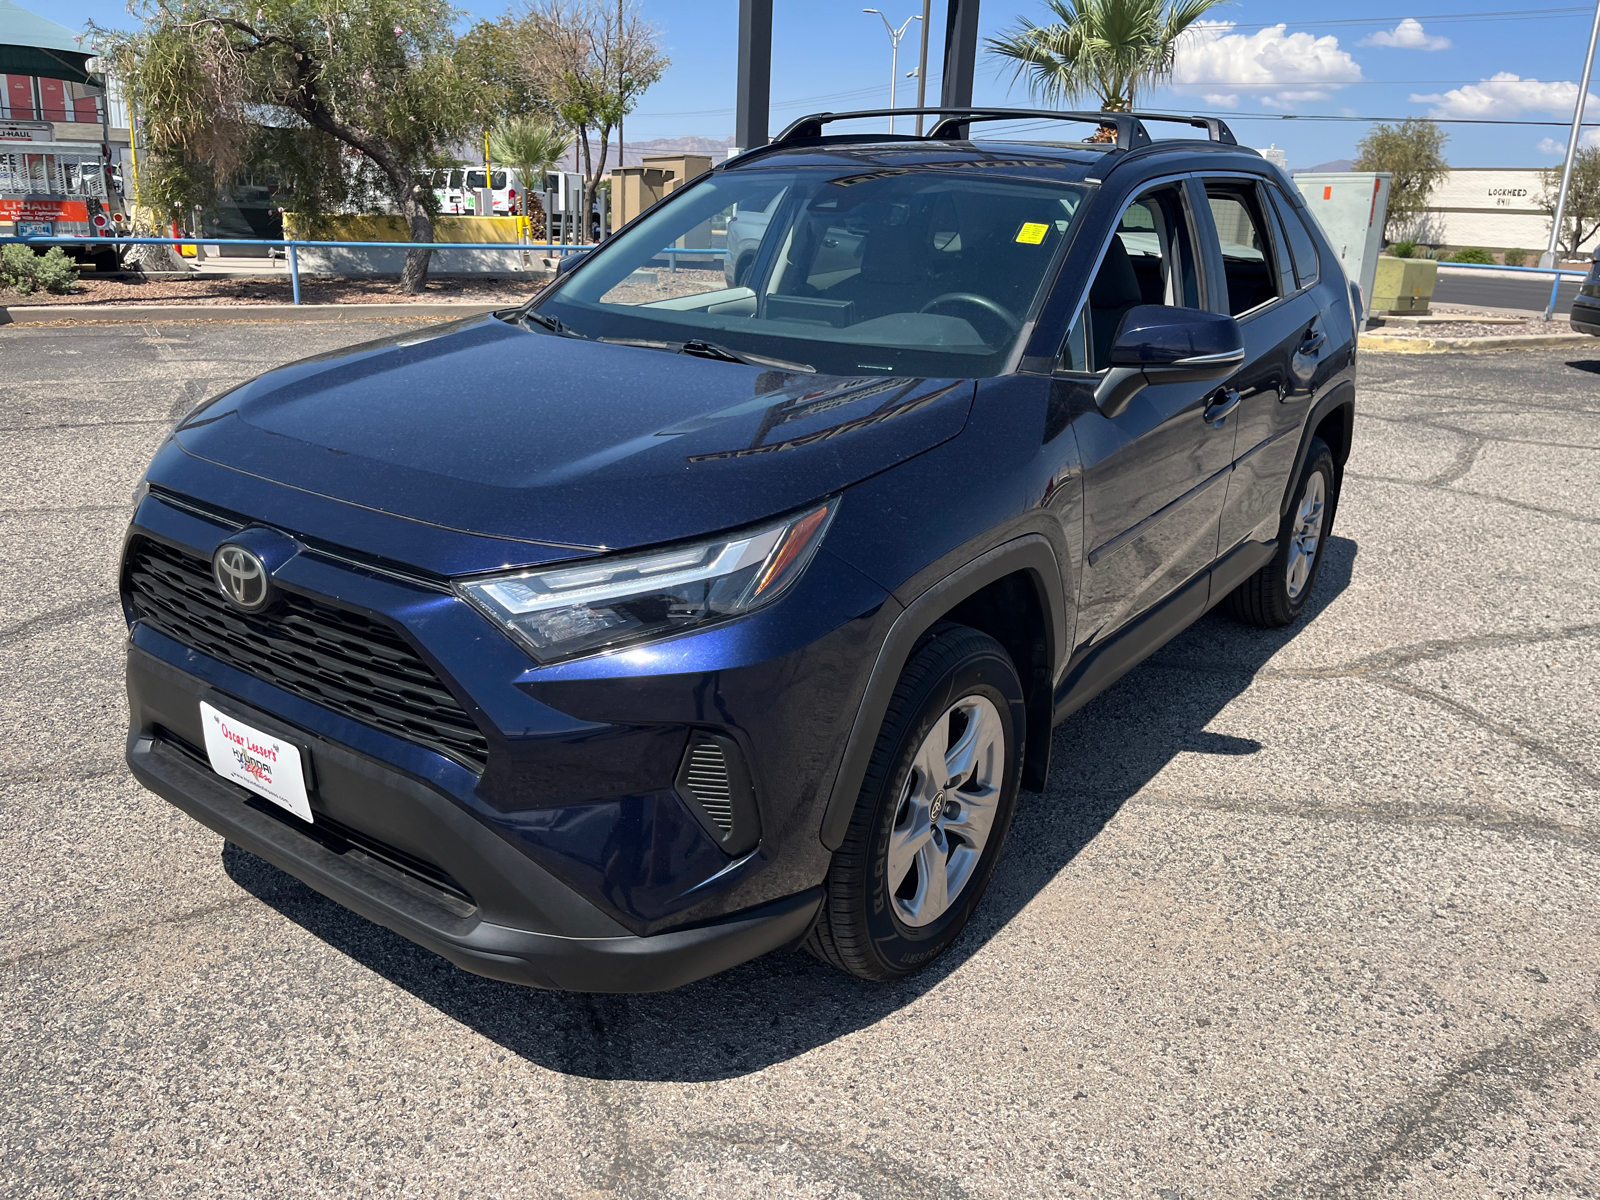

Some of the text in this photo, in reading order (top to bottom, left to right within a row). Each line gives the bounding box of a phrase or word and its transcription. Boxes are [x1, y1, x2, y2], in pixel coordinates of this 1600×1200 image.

[1488, 188, 1527, 197] LOCKHEED
[3, 201, 61, 210] U-HAUL
[221, 723, 277, 762] Oscar Leeser's
[232, 747, 273, 775] HYUNDAI
[254, 765, 272, 784] Paso
[873, 717, 930, 916] BLACKHAWK
